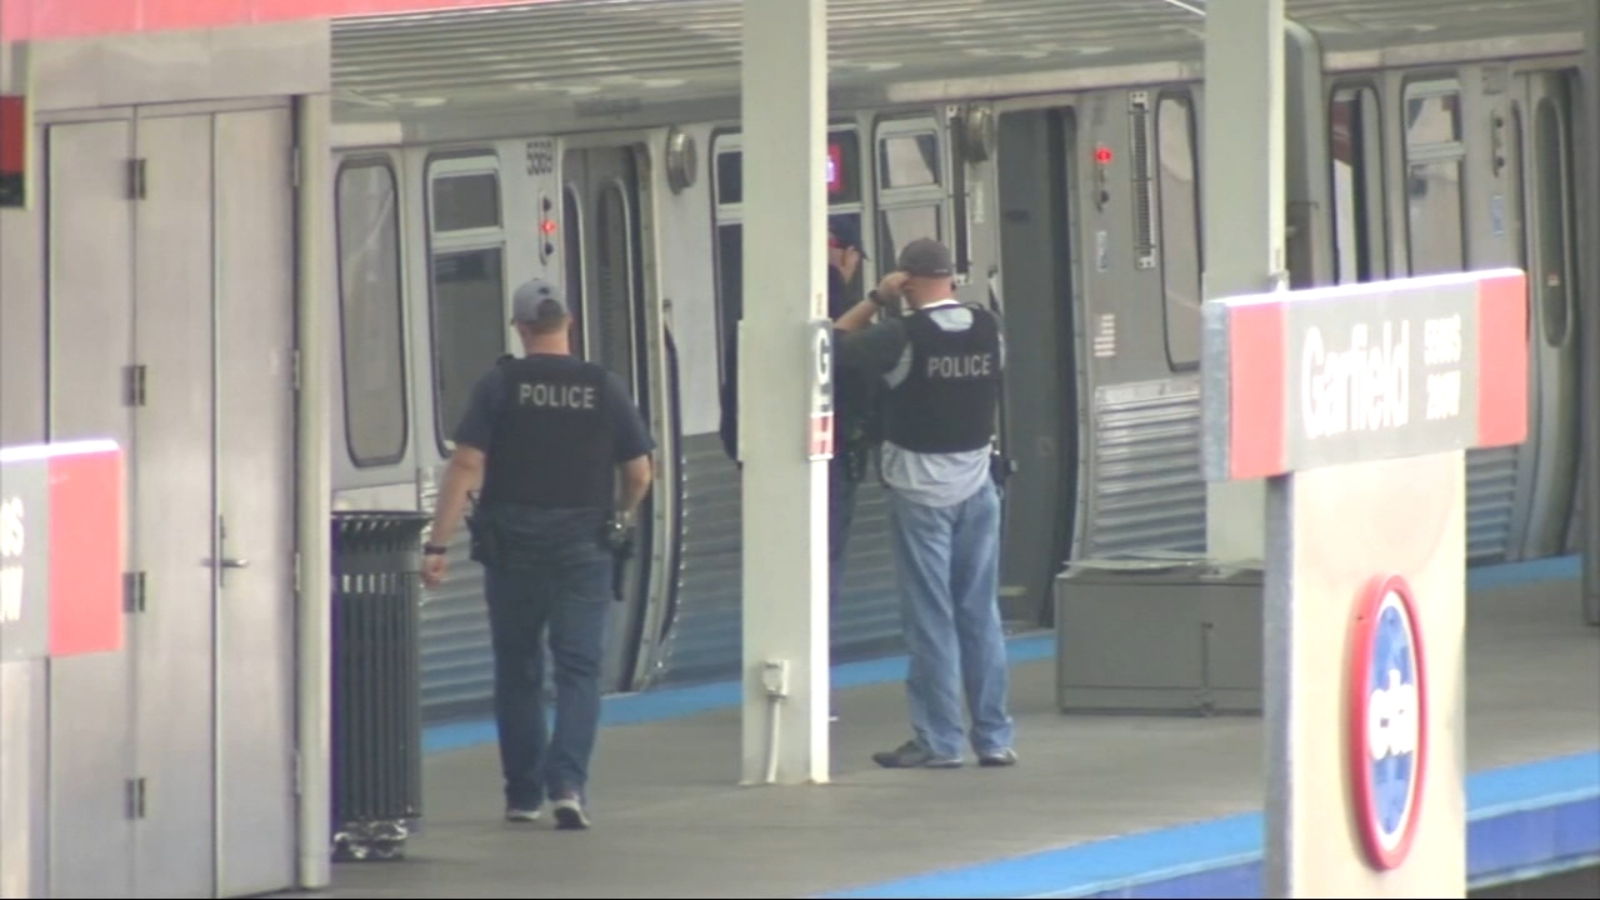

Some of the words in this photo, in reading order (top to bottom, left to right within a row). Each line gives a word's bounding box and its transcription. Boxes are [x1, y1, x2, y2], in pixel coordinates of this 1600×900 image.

[927, 354, 992, 378] POLICE
[1301, 320, 1410, 439] Garfield
[519, 383, 595, 409] POLICE
